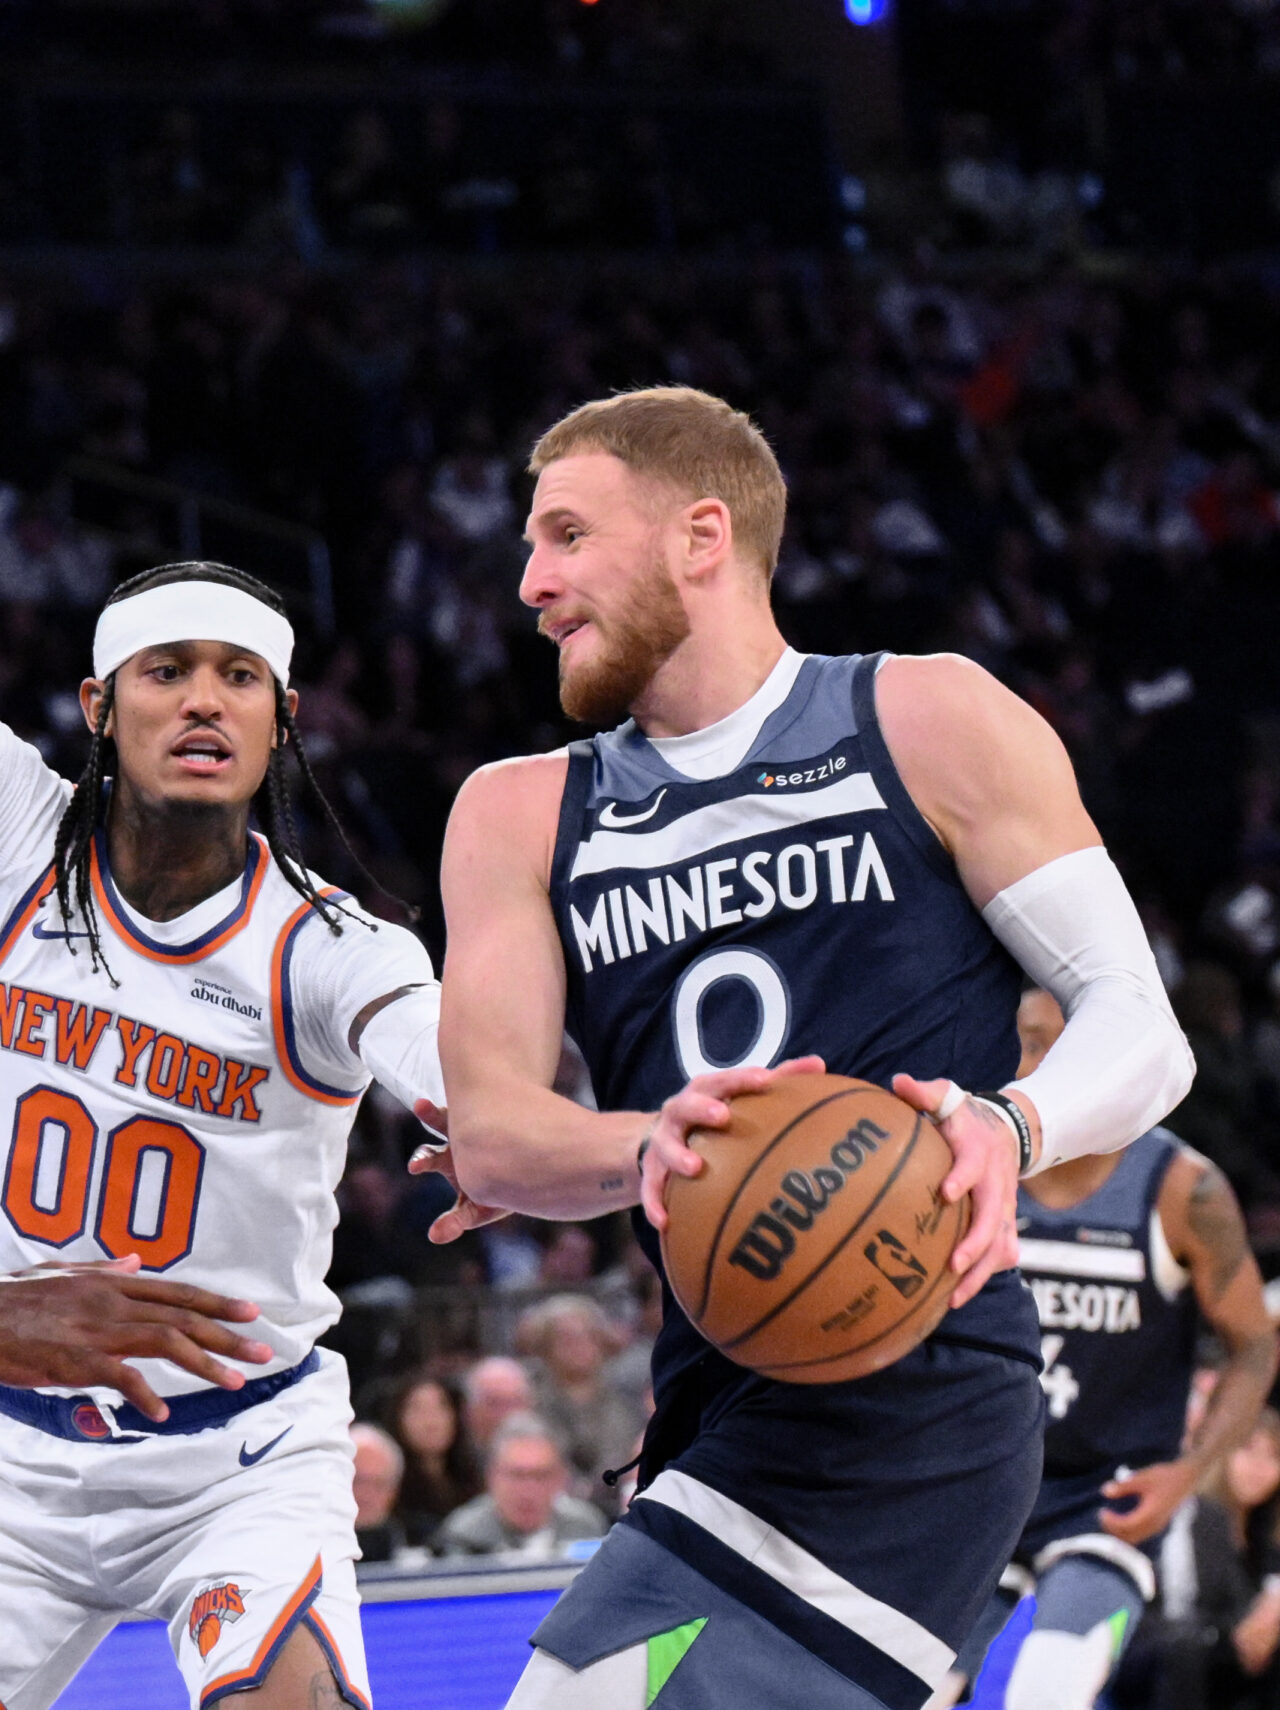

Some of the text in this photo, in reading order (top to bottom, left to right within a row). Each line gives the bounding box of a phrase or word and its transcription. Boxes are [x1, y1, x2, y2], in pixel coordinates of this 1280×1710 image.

[775, 756, 847, 787] sezzle
[569, 831, 896, 974] MINNESOTA
[190, 987, 263, 1021] abu dhabi
[670, 944, 793, 1081] 0
[114, 1015, 272, 1124] YORK
[0, 1083, 208, 1274] 00
[727, 1117, 892, 1282] Wilson
[1037, 1333, 1080, 1420] 4
